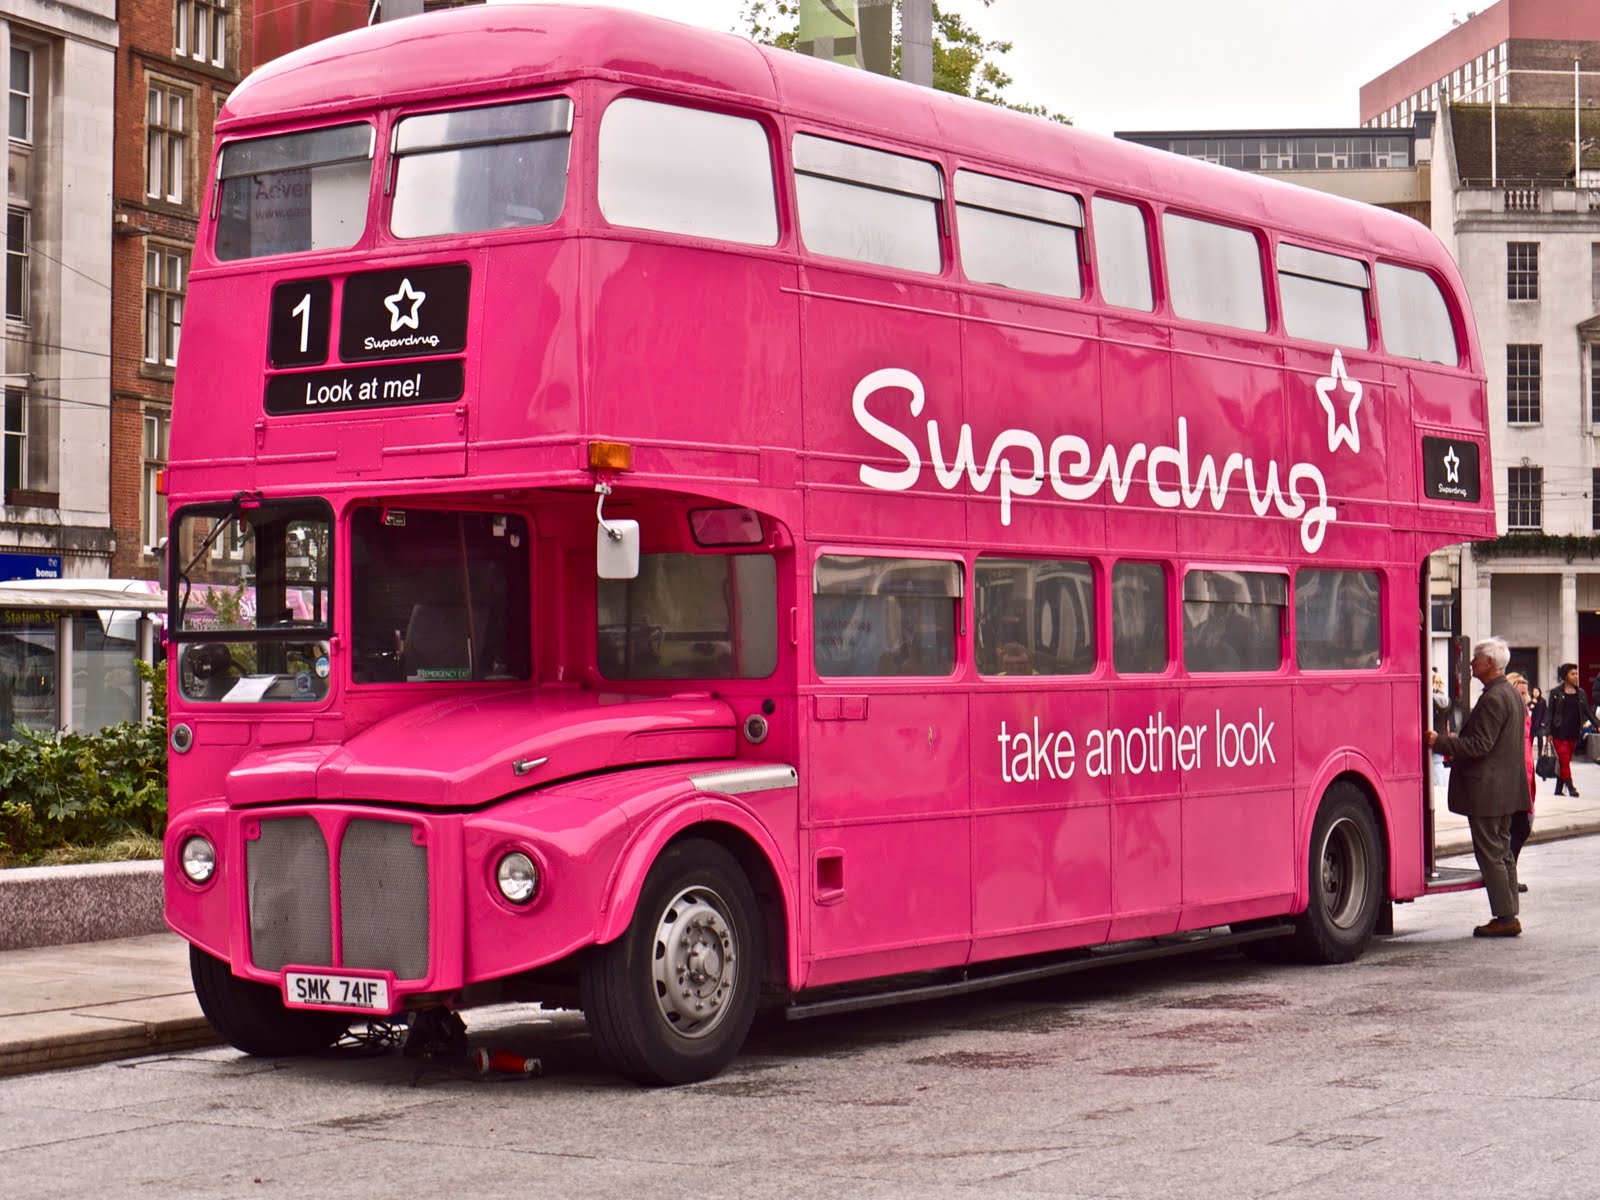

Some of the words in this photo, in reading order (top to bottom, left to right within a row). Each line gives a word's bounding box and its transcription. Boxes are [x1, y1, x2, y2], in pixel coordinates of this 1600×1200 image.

[291, 293, 311, 353] 1
[364, 333, 440, 351] Superdrug
[305, 379, 353, 405] Look
[358, 377, 378, 400] at
[383, 373, 421, 398] me!
[852, 366, 1337, 554] Superdrug
[1438, 483, 1467, 498] Superdrug
[48, 557, 58, 567] the
[36, 568, 58, 578] bonus
[5, 610, 41, 623] Station
[998, 715, 1075, 783] take
[1085, 711, 1207, 777] another
[1215, 707, 1276, 768] look
[296, 978, 331, 1000] SMK
[340, 981, 378, 1003] 741F
